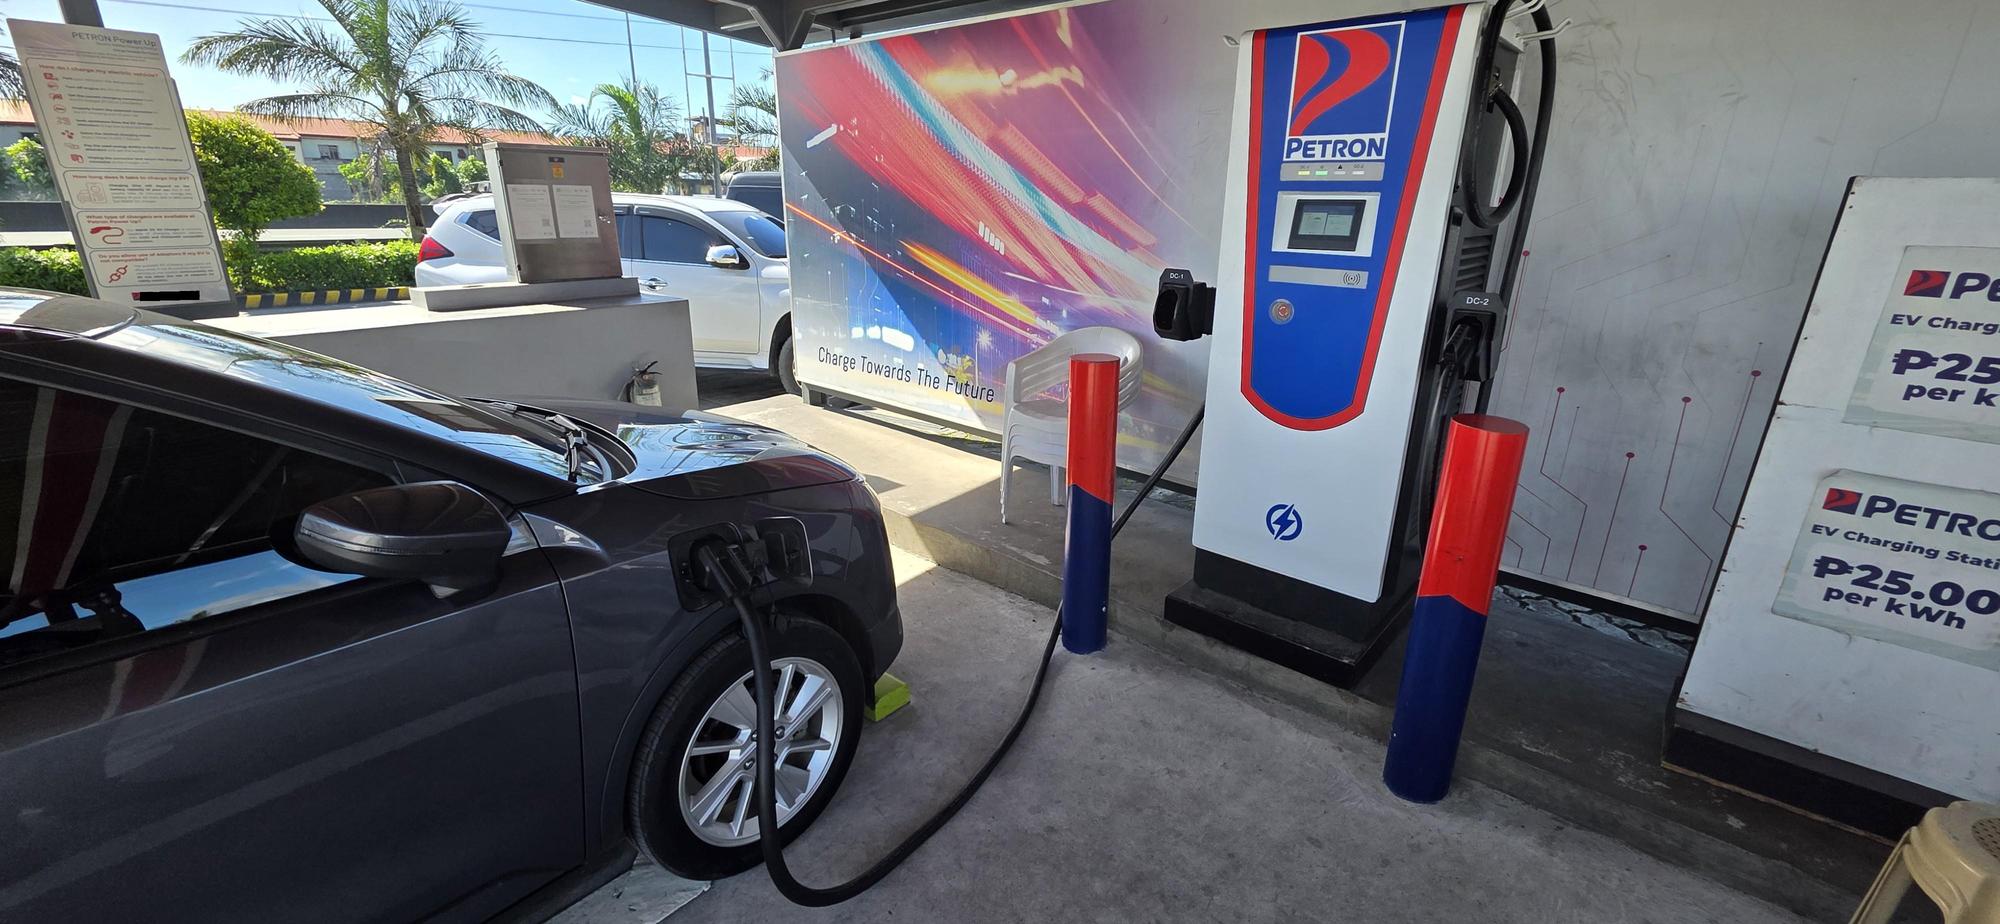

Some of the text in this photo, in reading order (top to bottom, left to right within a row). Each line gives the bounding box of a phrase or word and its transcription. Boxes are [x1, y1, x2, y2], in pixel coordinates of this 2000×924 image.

[71, 31, 112, 42] PETRON
[113, 36, 142, 45] Power
[143, 39, 156, 47] Up
[1285, 137, 1385, 159] PETRON
[1466, 296, 1490, 306] DC-2
[1890, 313, 2000, 335] EV Charg
[818, 346, 995, 403] Charge Towards The Future
[1902, 383, 1966, 402] per
[1862, 494, 2000, 541] PETRO
[1810, 524, 2000, 570] EV Charging Stati
[1813, 555, 2000, 615] ₱25.00
[1822, 586, 1966, 630] per kWh
